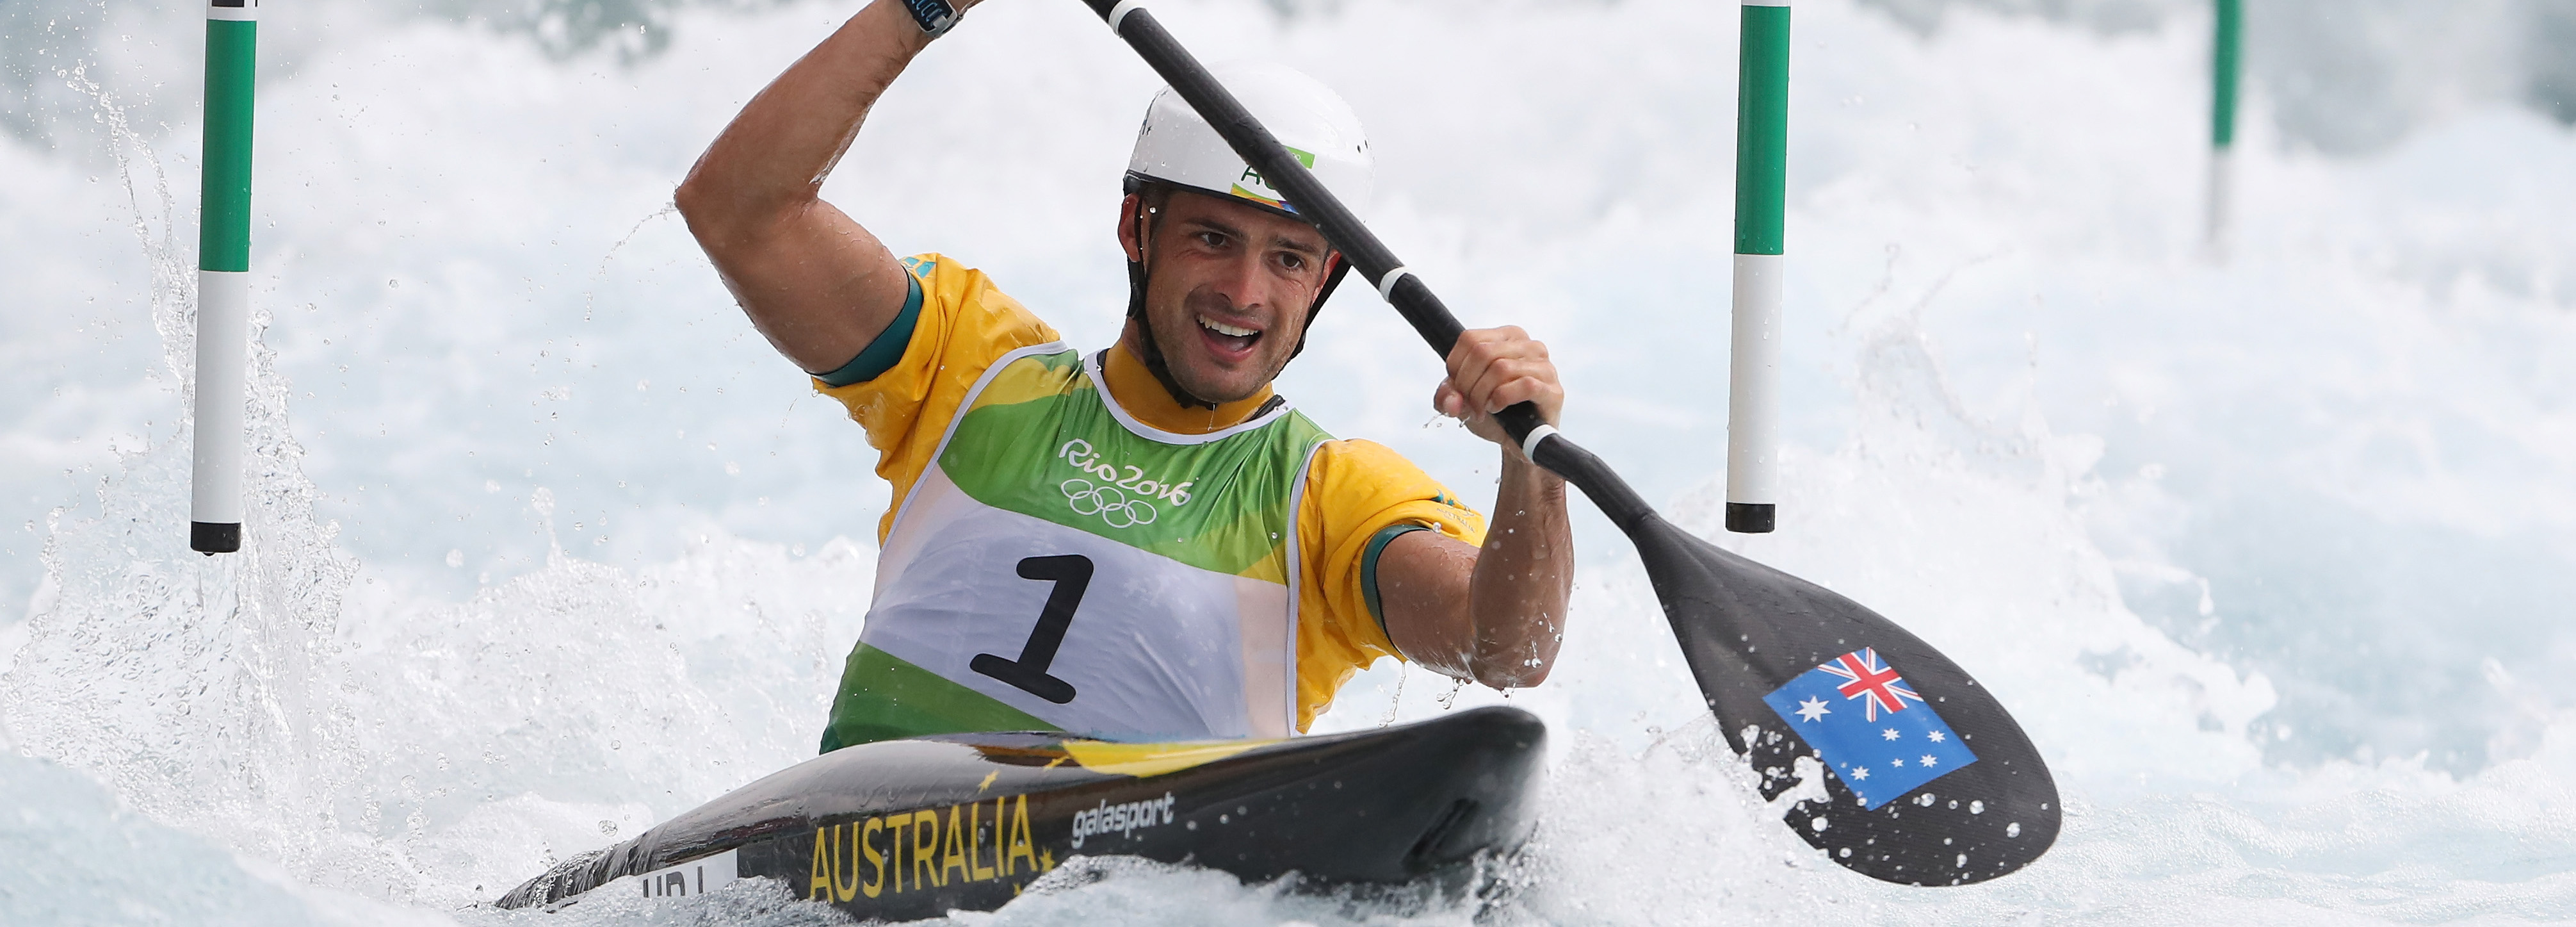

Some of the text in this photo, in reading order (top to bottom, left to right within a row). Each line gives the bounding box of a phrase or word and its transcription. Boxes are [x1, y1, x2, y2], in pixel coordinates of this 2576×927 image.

[969, 554, 1094, 704] 1
[809, 794, 1038, 903] AUSTRALIA
[1071, 791, 1176, 849] galasport
